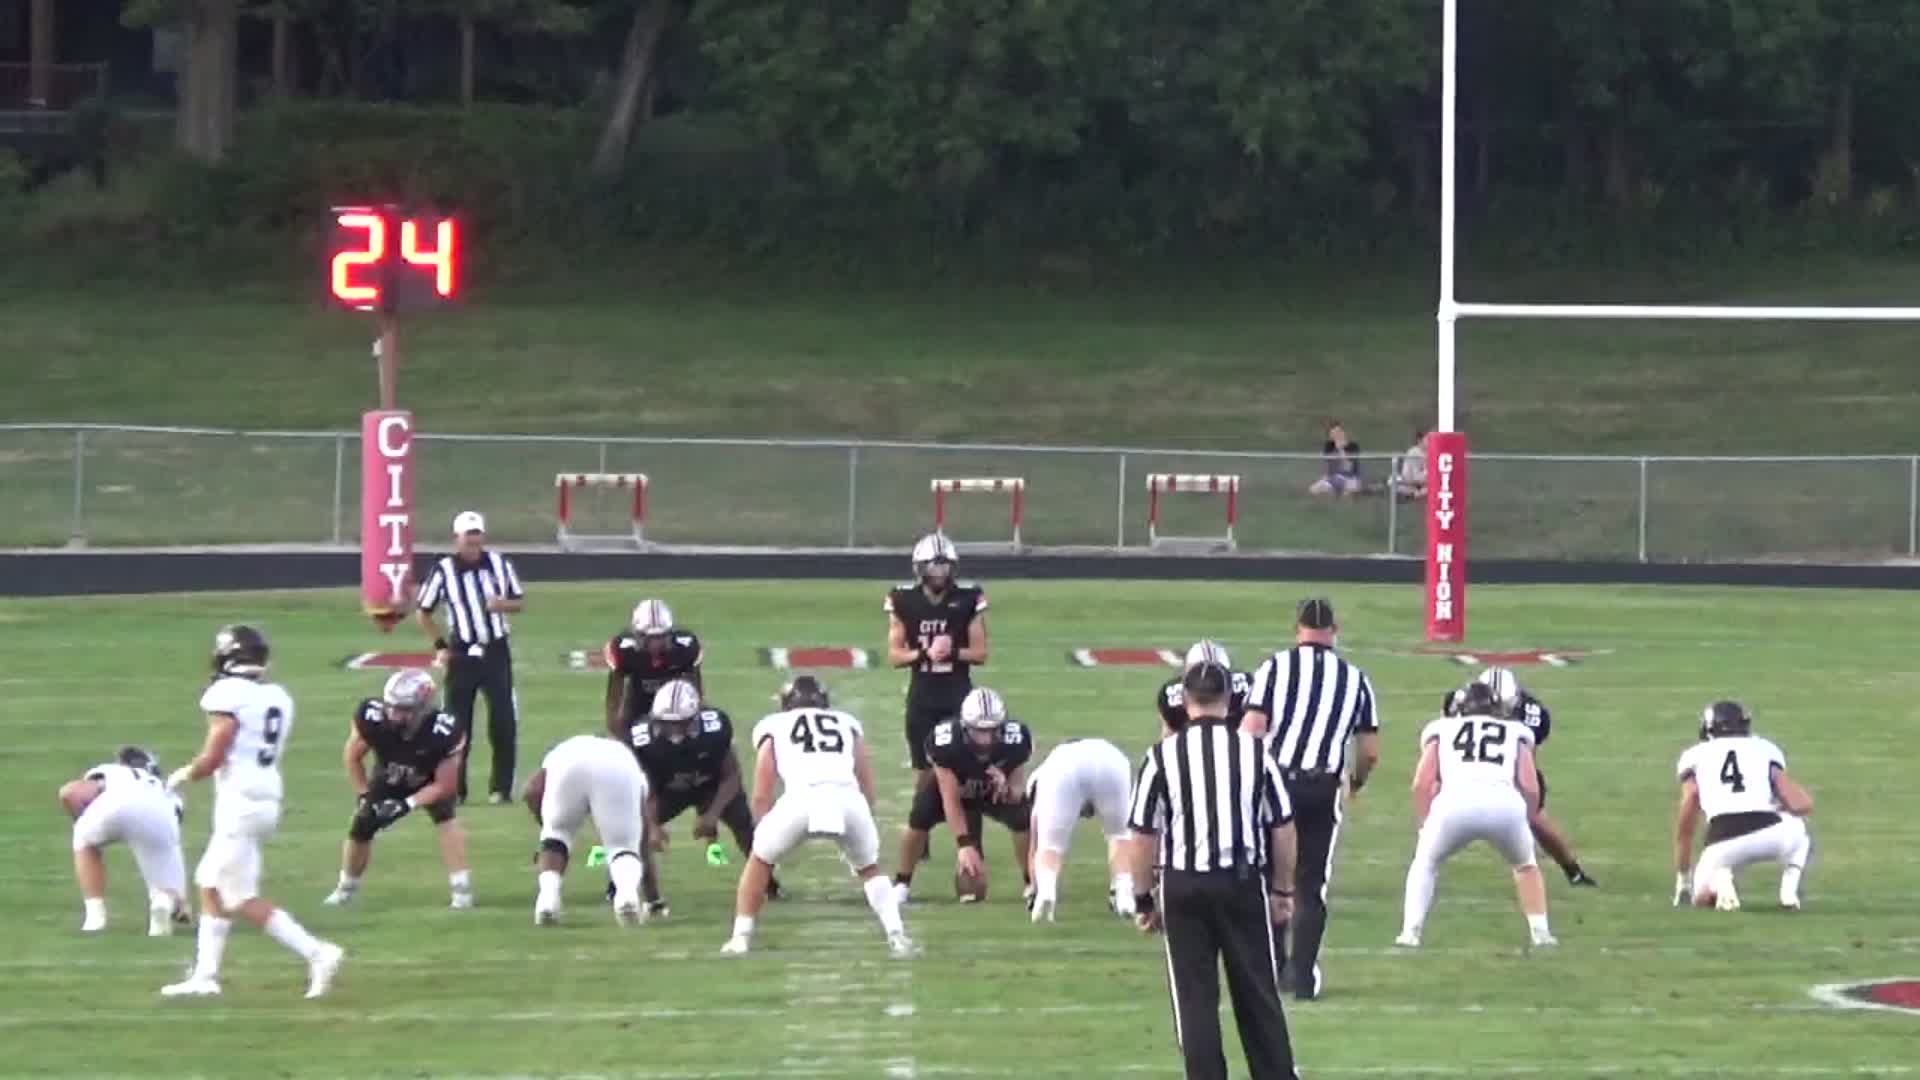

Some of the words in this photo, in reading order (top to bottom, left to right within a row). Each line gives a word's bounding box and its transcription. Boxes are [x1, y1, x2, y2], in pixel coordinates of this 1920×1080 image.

[331, 213, 456, 300] 24
[377, 416, 410, 601] CITY
[1435, 452, 1455, 530] CITY
[918, 634, 953, 673] 1
[256, 705, 283, 769] 9
[431, 712, 456, 736] 72
[701, 710, 723, 733] 60
[789, 713, 845, 753] 45
[1004, 721, 1023, 745] 50
[1453, 719, 1507, 766] 42
[1720, 749, 1745, 793] 4
